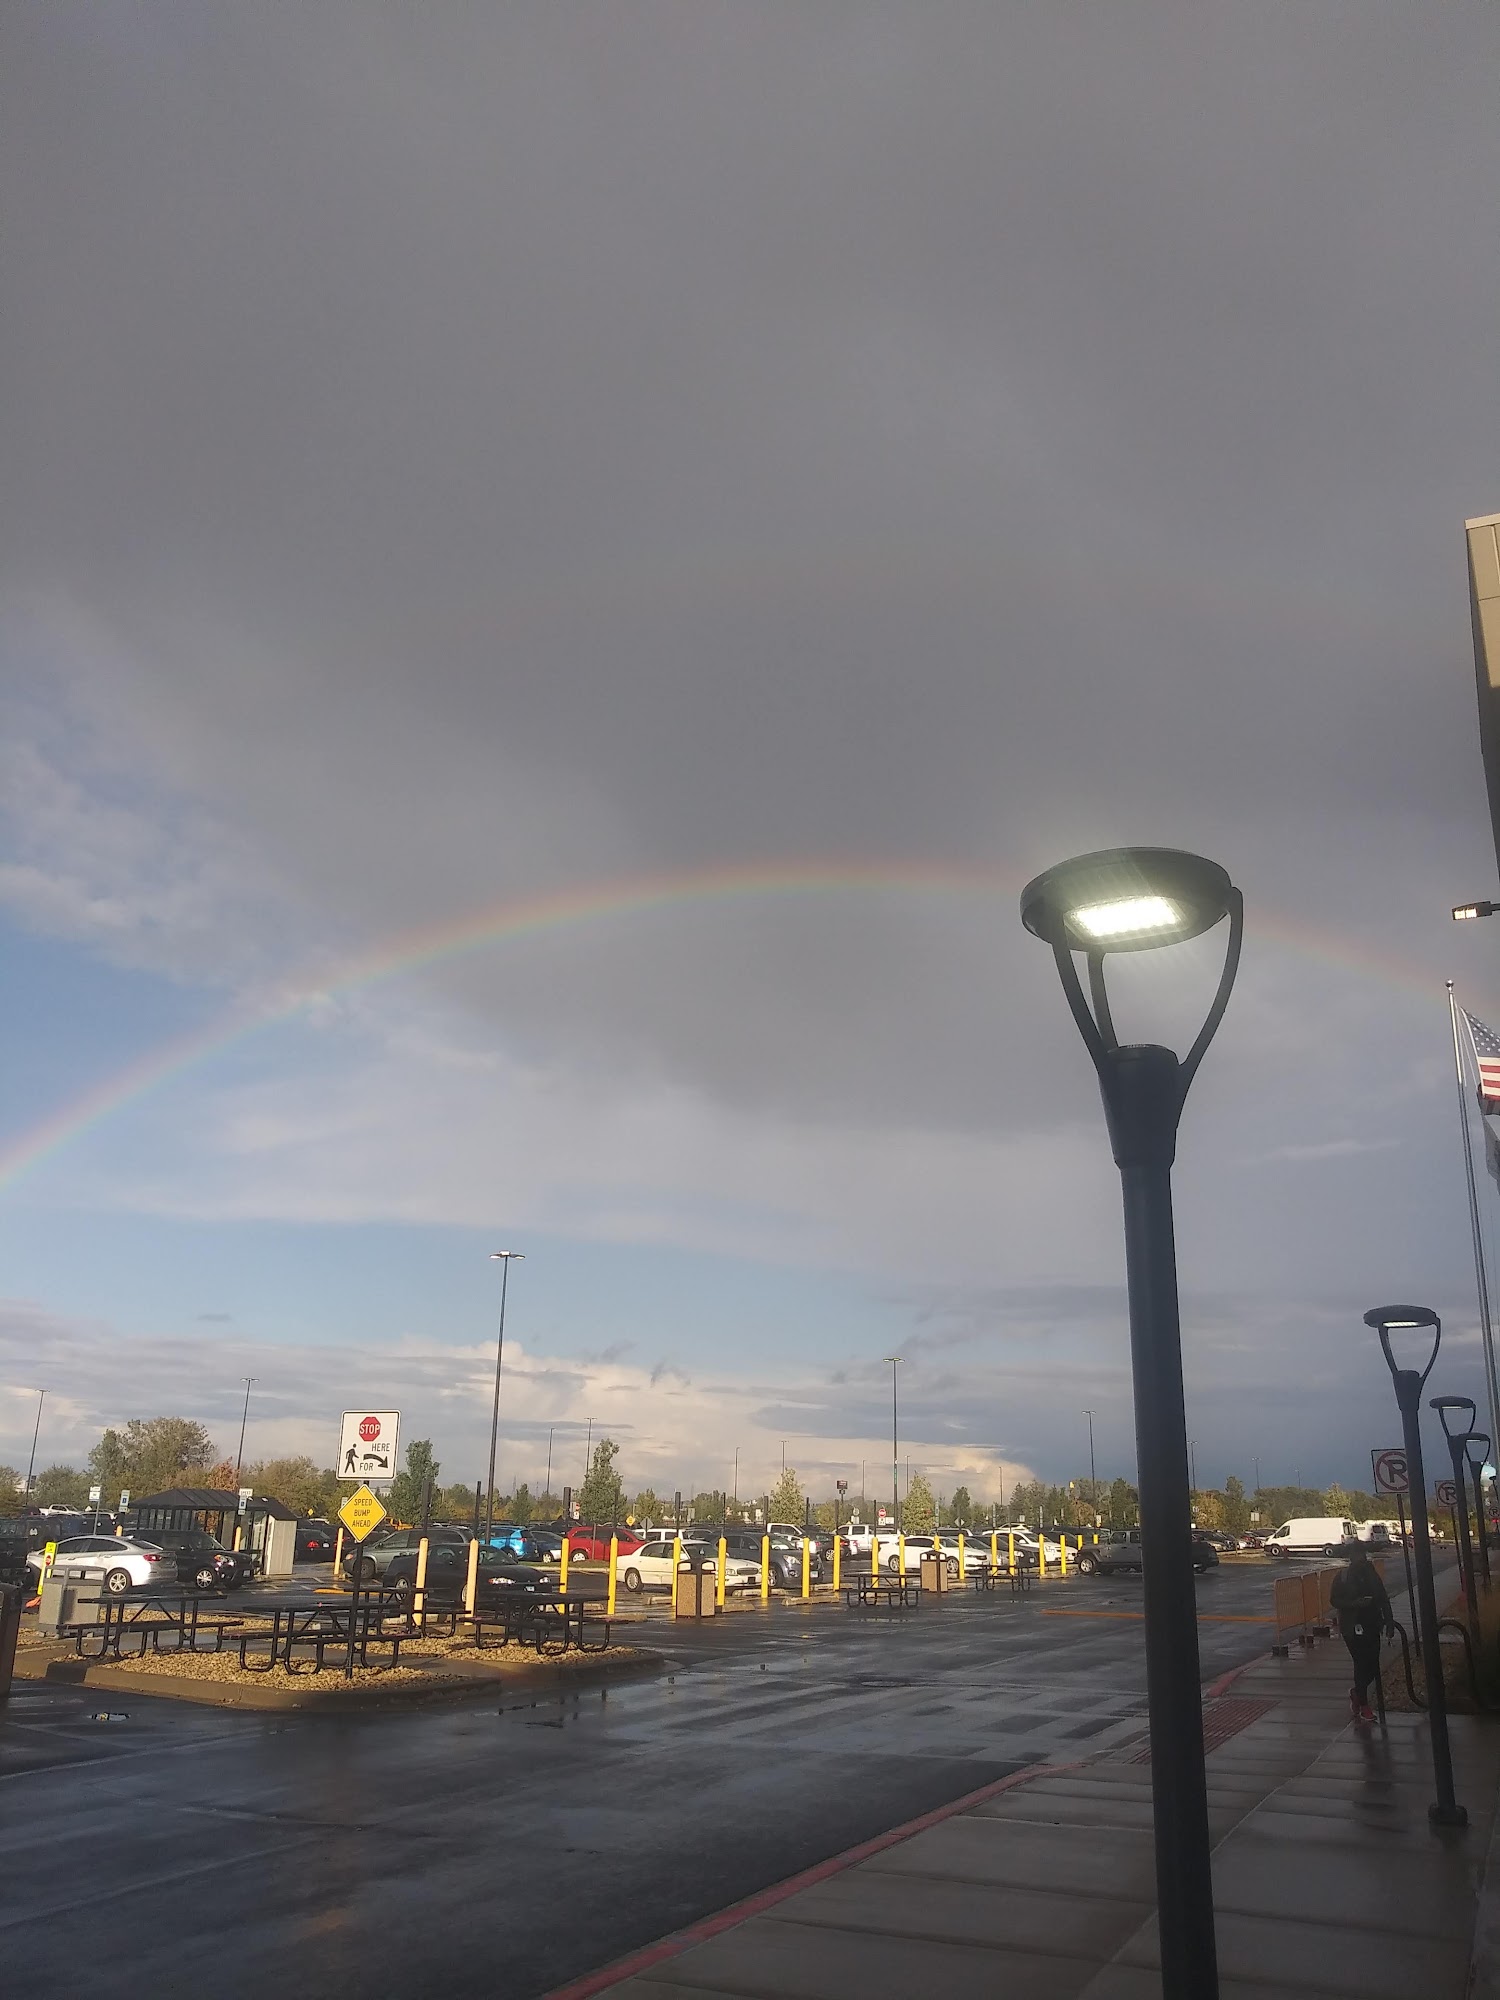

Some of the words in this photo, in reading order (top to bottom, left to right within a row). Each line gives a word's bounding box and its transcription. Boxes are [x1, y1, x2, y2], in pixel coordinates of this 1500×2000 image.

[360, 1424, 380, 1434] STOP
[371, 1443, 390, 1451] HERE
[360, 1463, 374, 1471] FOR
